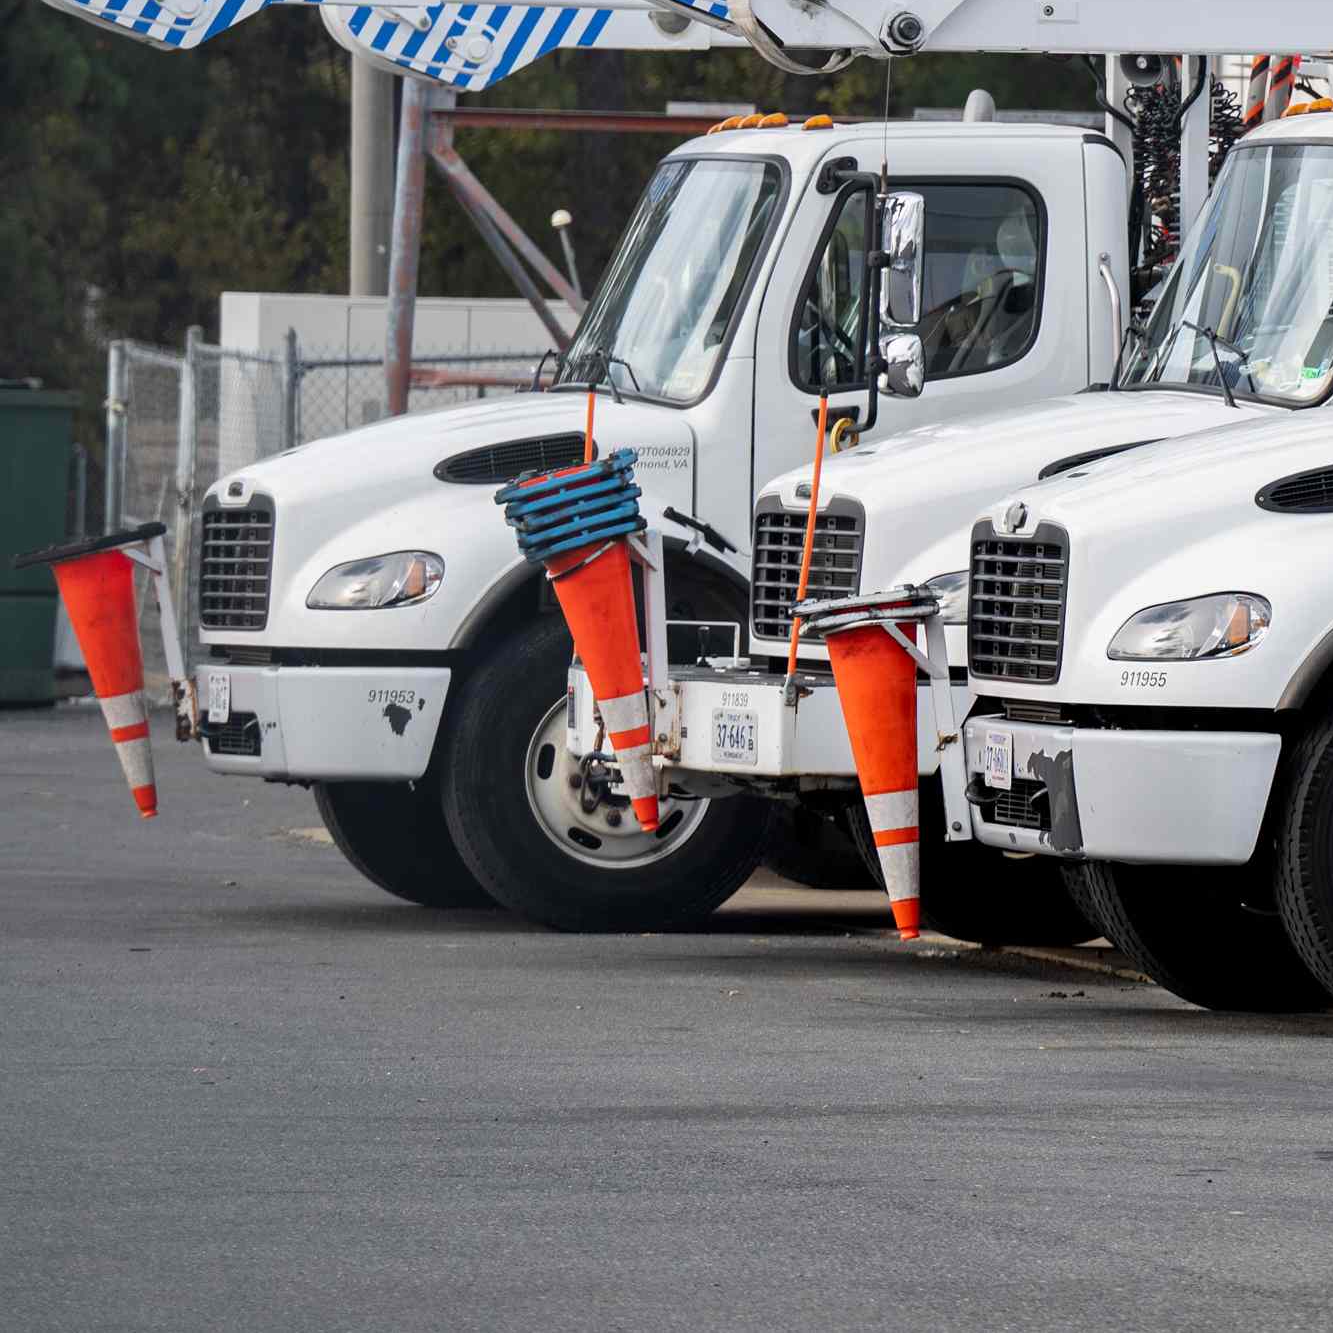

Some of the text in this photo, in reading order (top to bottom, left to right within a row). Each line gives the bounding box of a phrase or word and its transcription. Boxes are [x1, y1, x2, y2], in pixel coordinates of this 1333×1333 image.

[673, 459, 688, 469] VA
[1121, 670, 1168, 687] 911955
[368, 689, 416, 704] 911953
[722, 690, 749, 707] 911839
